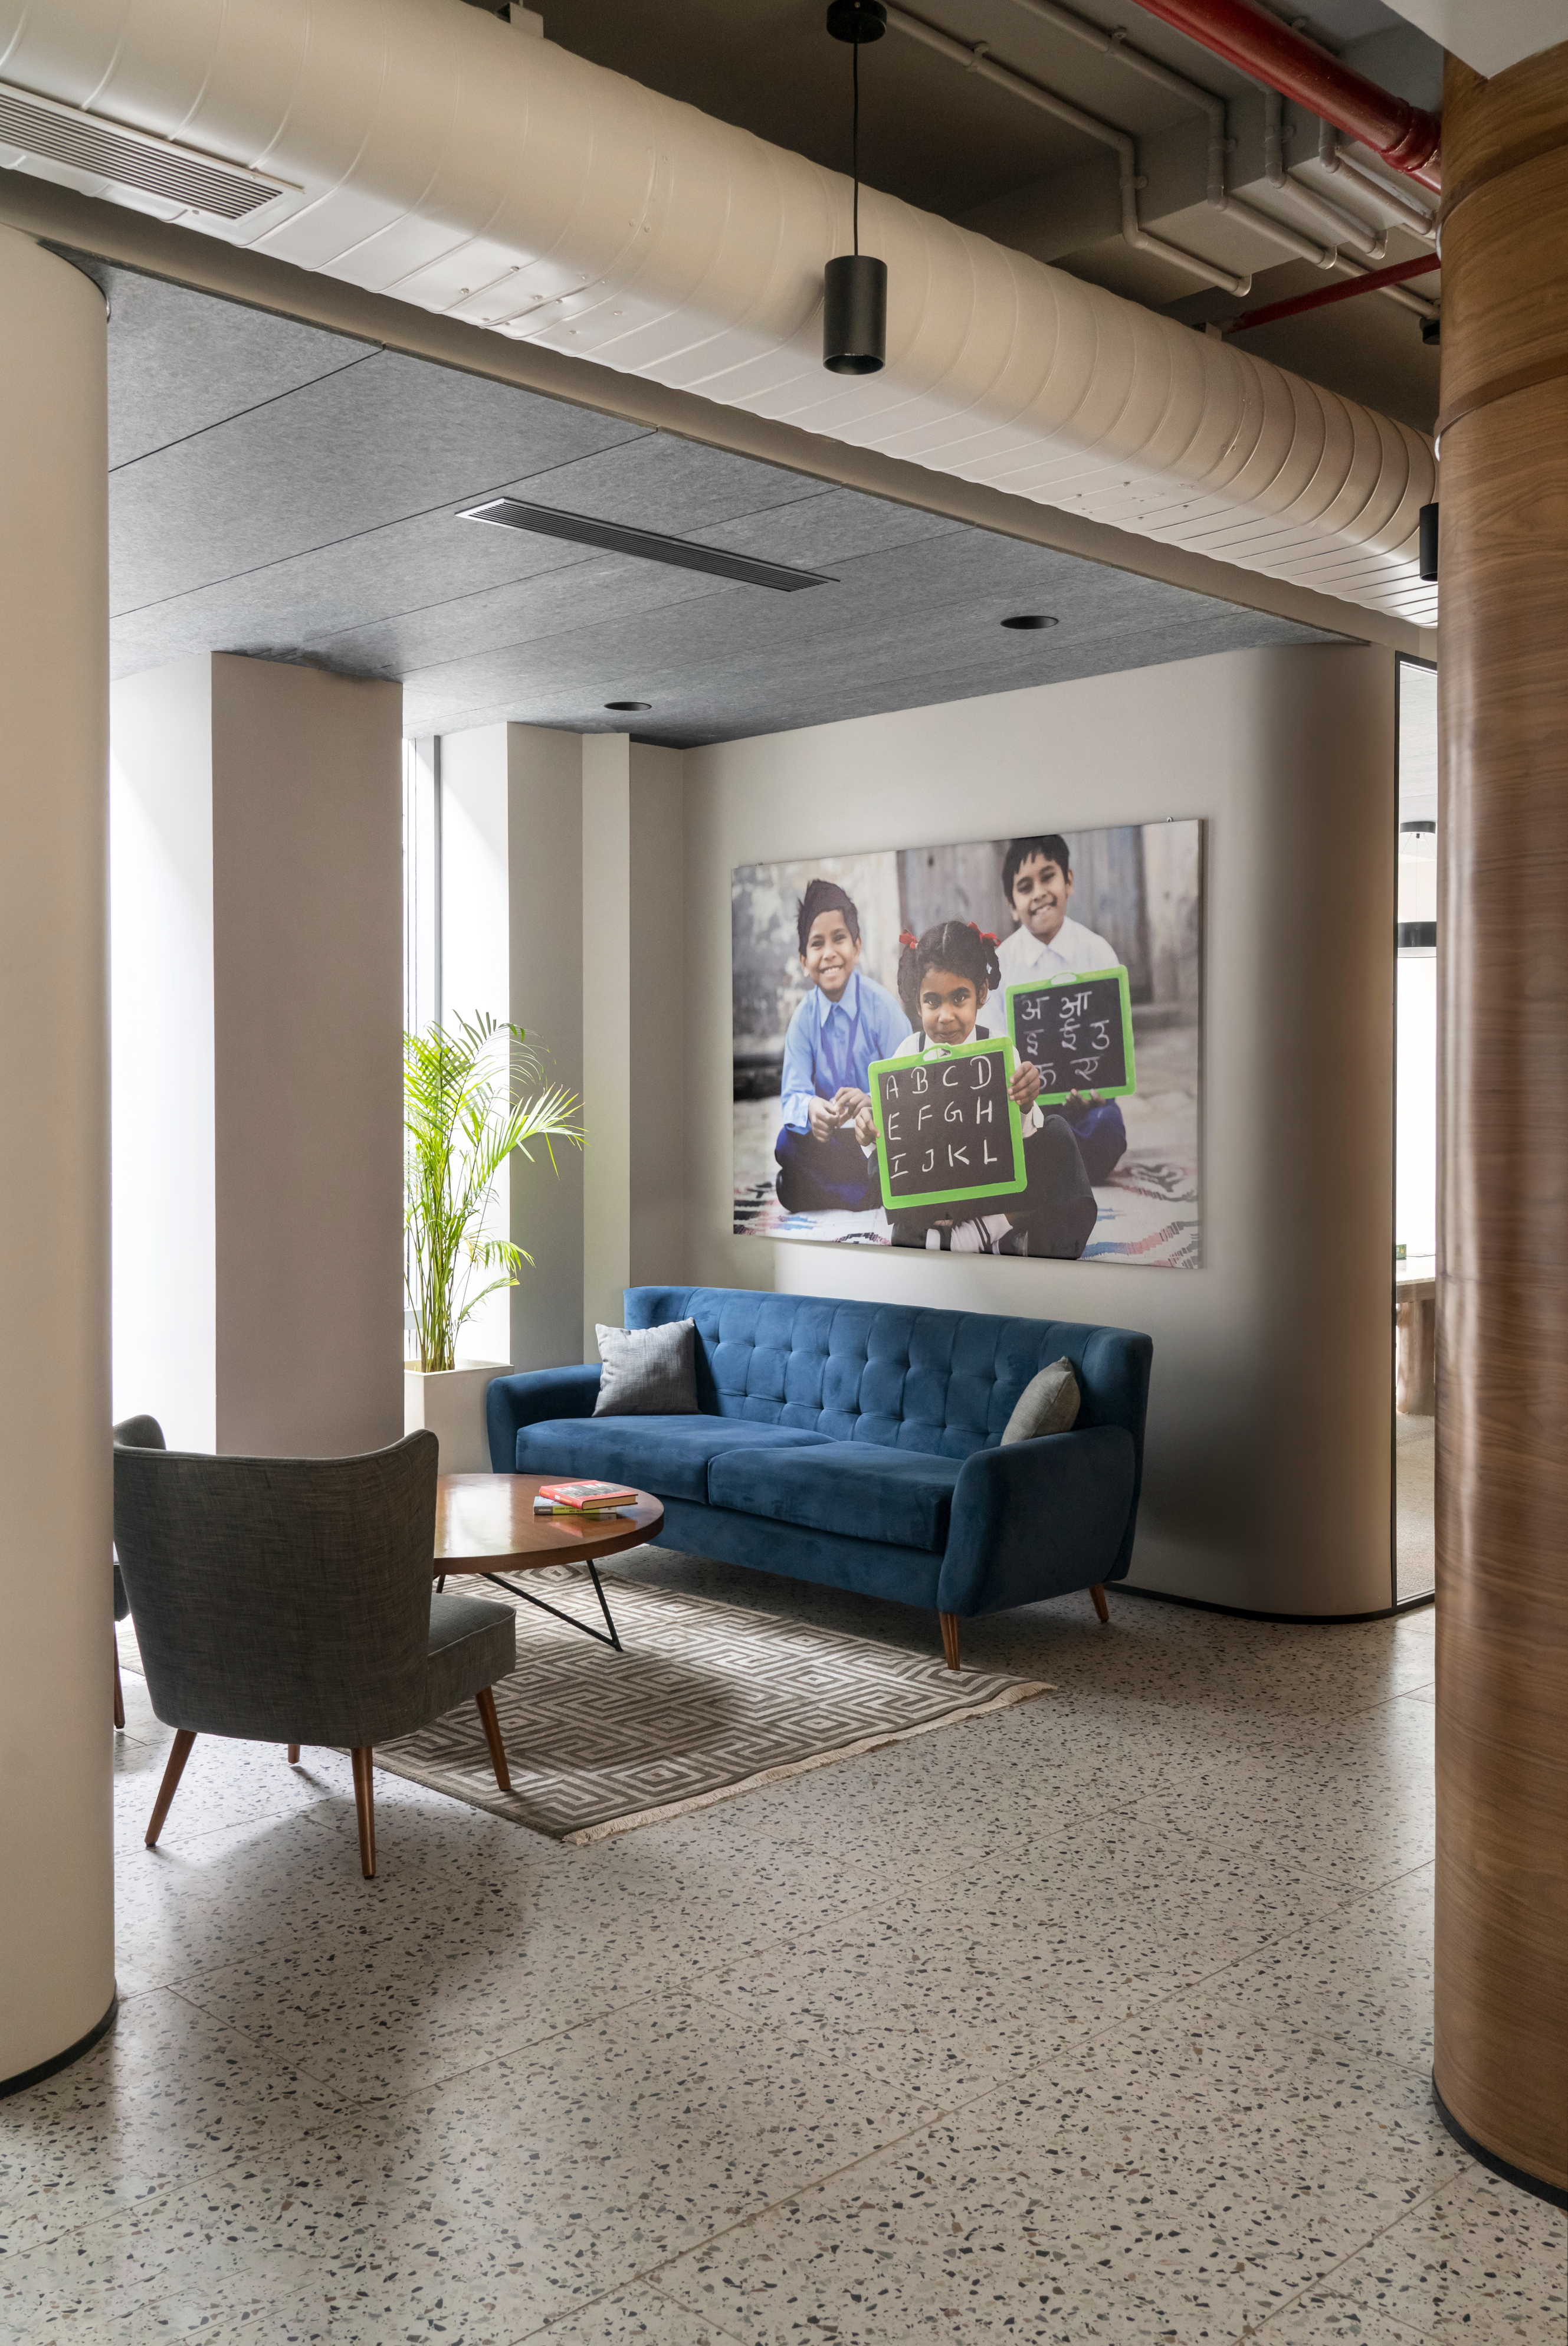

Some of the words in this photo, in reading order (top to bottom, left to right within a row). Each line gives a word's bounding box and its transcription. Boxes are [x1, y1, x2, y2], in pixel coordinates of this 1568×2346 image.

[1021, 995, 1050, 1020] अ
[1059, 991, 1093, 1019] आ
[1024, 1028, 1045, 1056] इ
[1059, 1018, 1081, 1050] ई
[1090, 1019, 1110, 1050] उ
[887, 1075, 898, 1100] A
[911, 1066, 929, 1094] B
[943, 1066, 959, 1087] C
[970, 1055, 992, 1090] D
[888, 1112, 901, 1140] E
[918, 1105, 933, 1131] F
[944, 1101, 963, 1122] G
[976, 1096, 992, 1124] H
[890, 1152, 908, 1179] I
[922, 1148, 934, 1172] J
[948, 1144, 970, 1167] K
[983, 1138, 998, 1165] L
